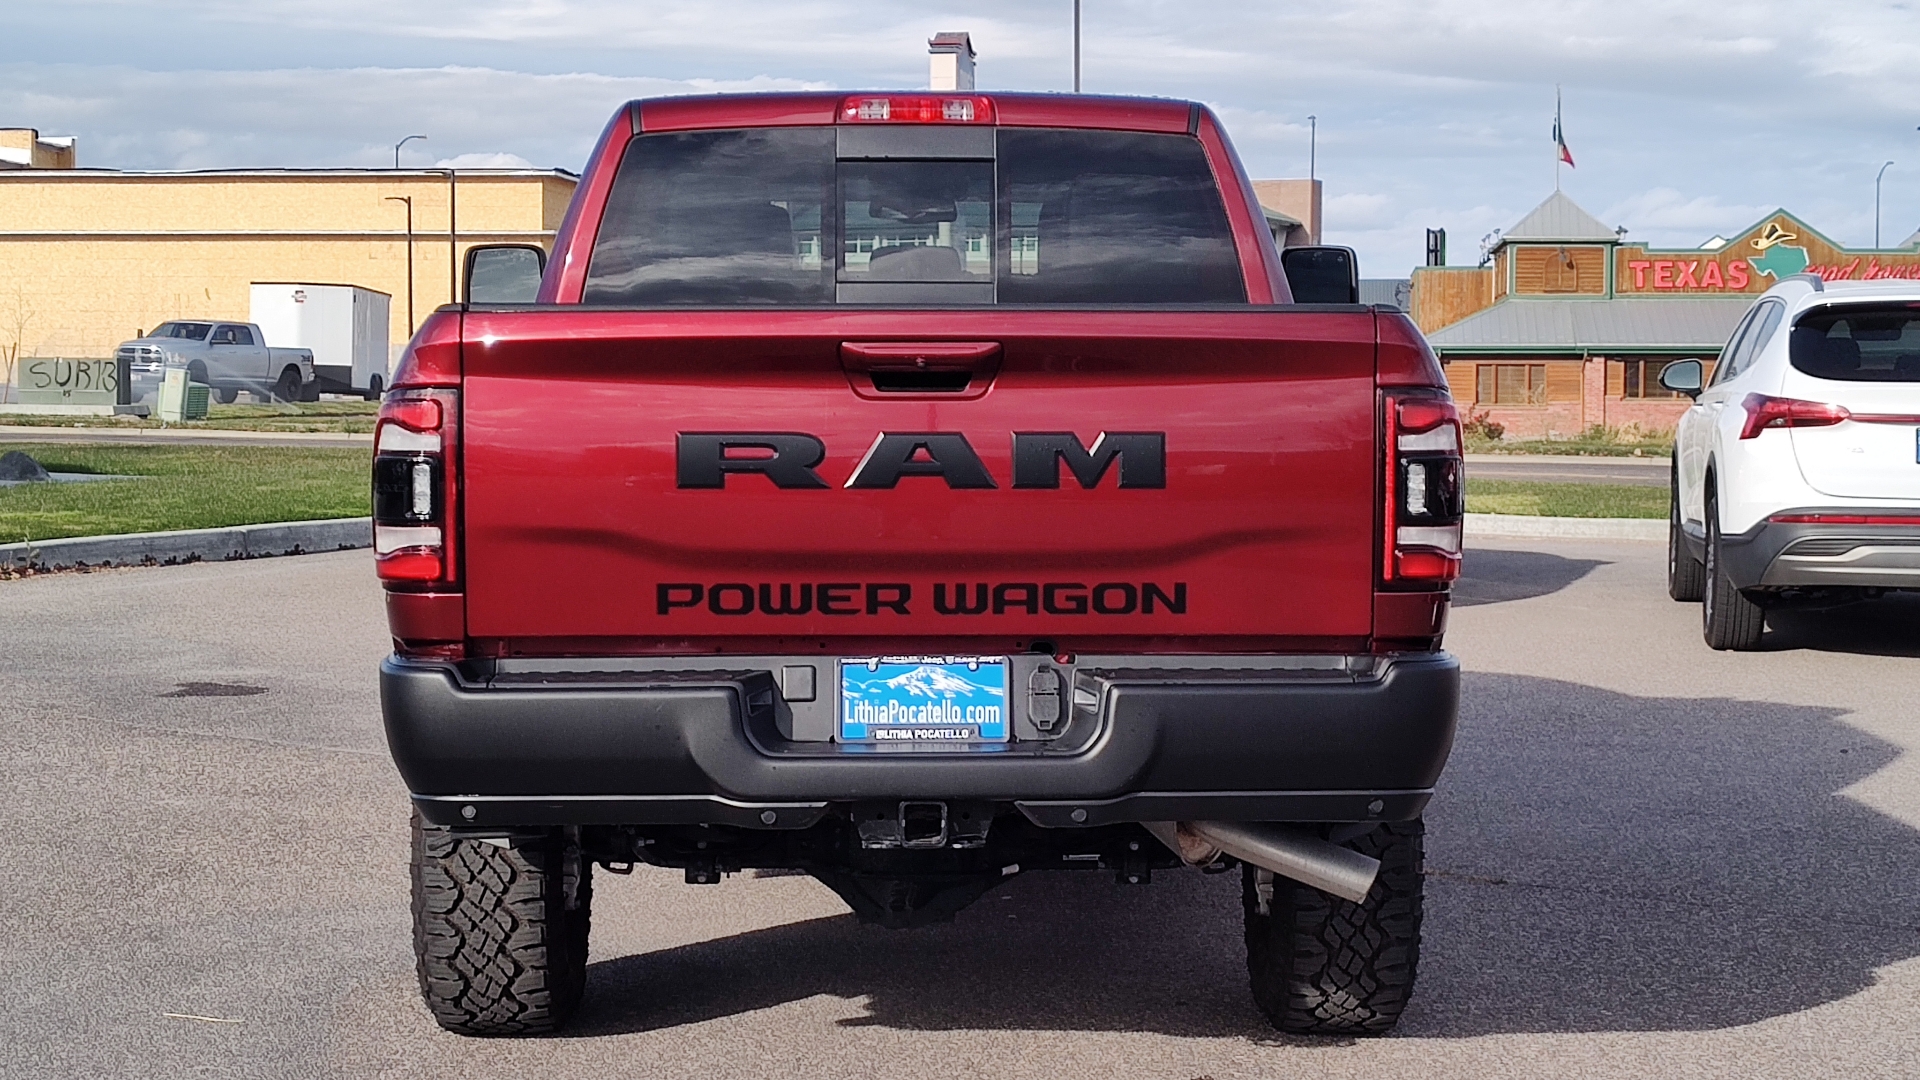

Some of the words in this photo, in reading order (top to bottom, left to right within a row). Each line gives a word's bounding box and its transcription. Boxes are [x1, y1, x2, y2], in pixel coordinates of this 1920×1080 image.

[1628, 259, 1749, 289] TEXAS
[675, 430, 1166, 490] RAM
[656, 582, 911, 616] POWER
[932, 582, 1187, 616] WAGON
[844, 699, 1000, 724] LithiaPocatello.com
[885, 729, 913, 740] LITHIA
[914, 729, 969, 740] POCATELLO
